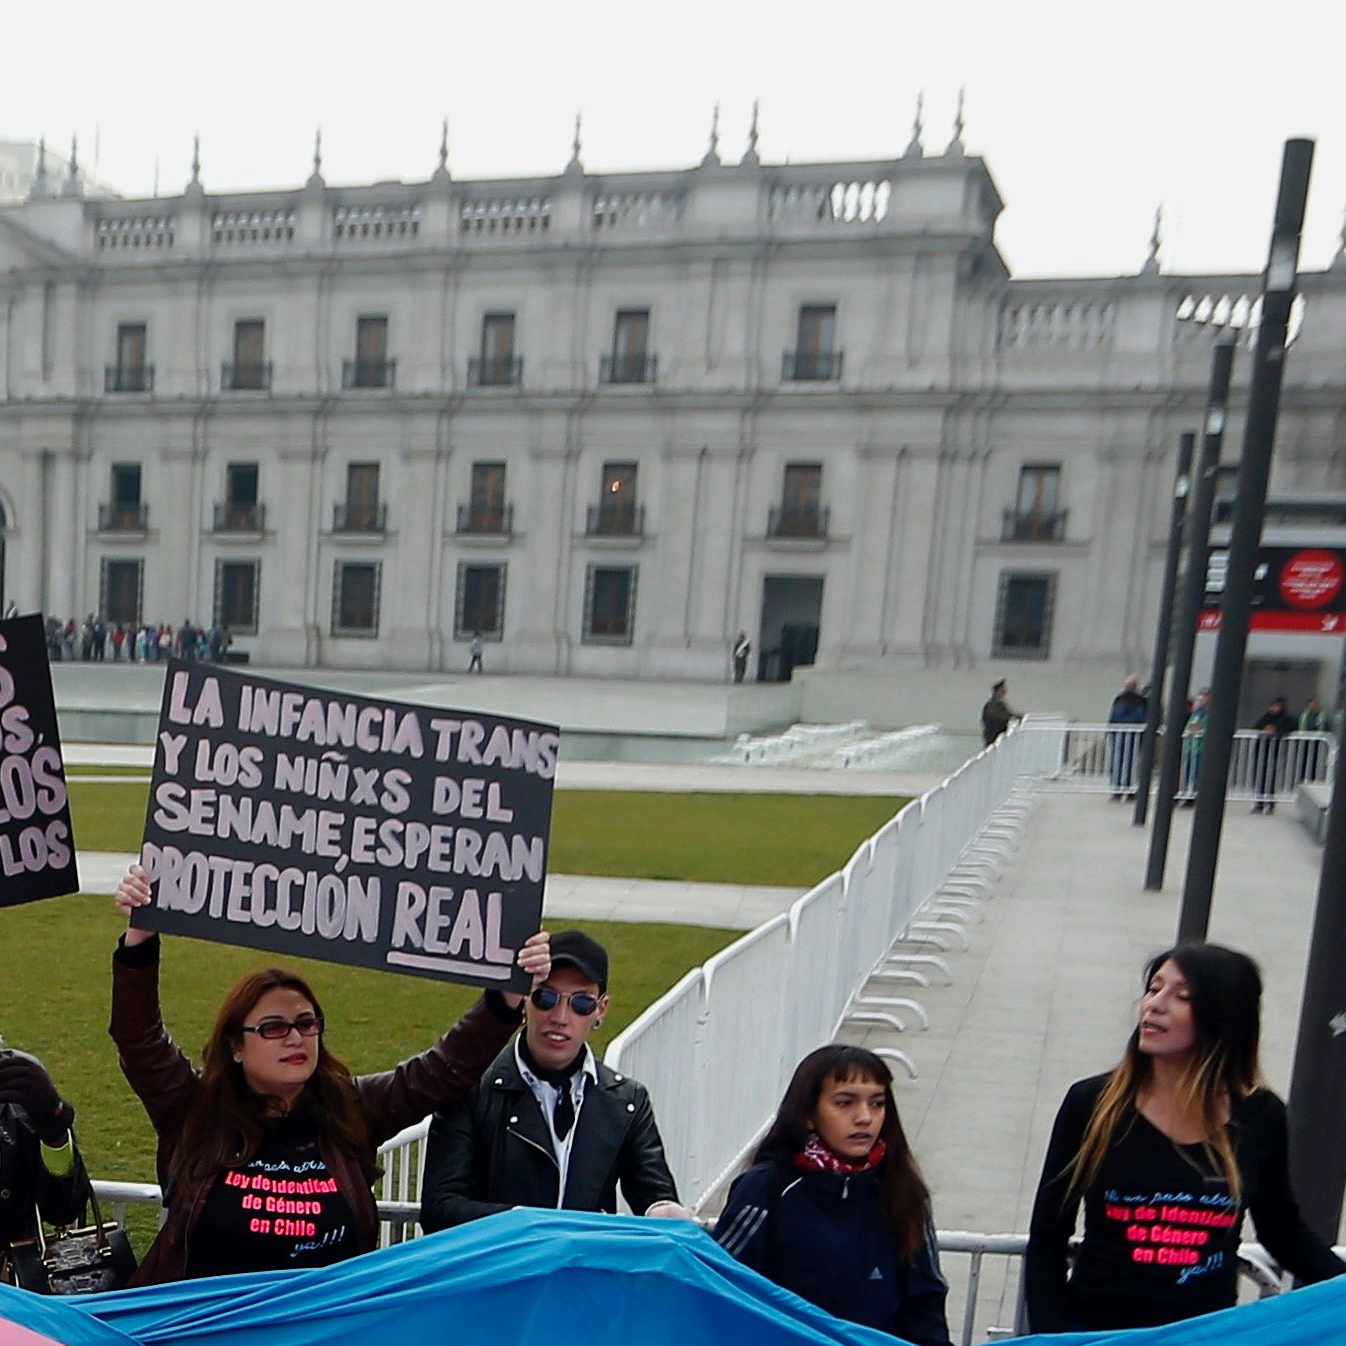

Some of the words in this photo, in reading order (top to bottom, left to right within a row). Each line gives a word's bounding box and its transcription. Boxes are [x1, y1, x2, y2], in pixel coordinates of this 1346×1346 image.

[168, 671, 223, 728] LA
[238, 685, 424, 759] INFANCIA
[430, 718, 559, 780] TRANS
[159, 731, 187, 776] Y
[195, 737, 264, 789] LOS
[274, 751, 413, 815] NIÑXS
[432, 776, 513, 823] DEL
[351, 815, 544, 883] ESPERAN
[391, 880, 515, 965] REAL
[225, 1171, 250, 1189] Ley
[252, 1174, 270, 1191] de
[242, 1194, 262, 1210] de
[265, 1196, 322, 1215] Género
[1134, 1205, 1157, 1221] de
[250, 1218, 270, 1233] en
[274, 1218, 316, 1236] Chile
[1127, 1224, 1147, 1241] de
[1132, 1247, 1154, 1262] en
[1157, 1247, 1200, 1265] Chile
